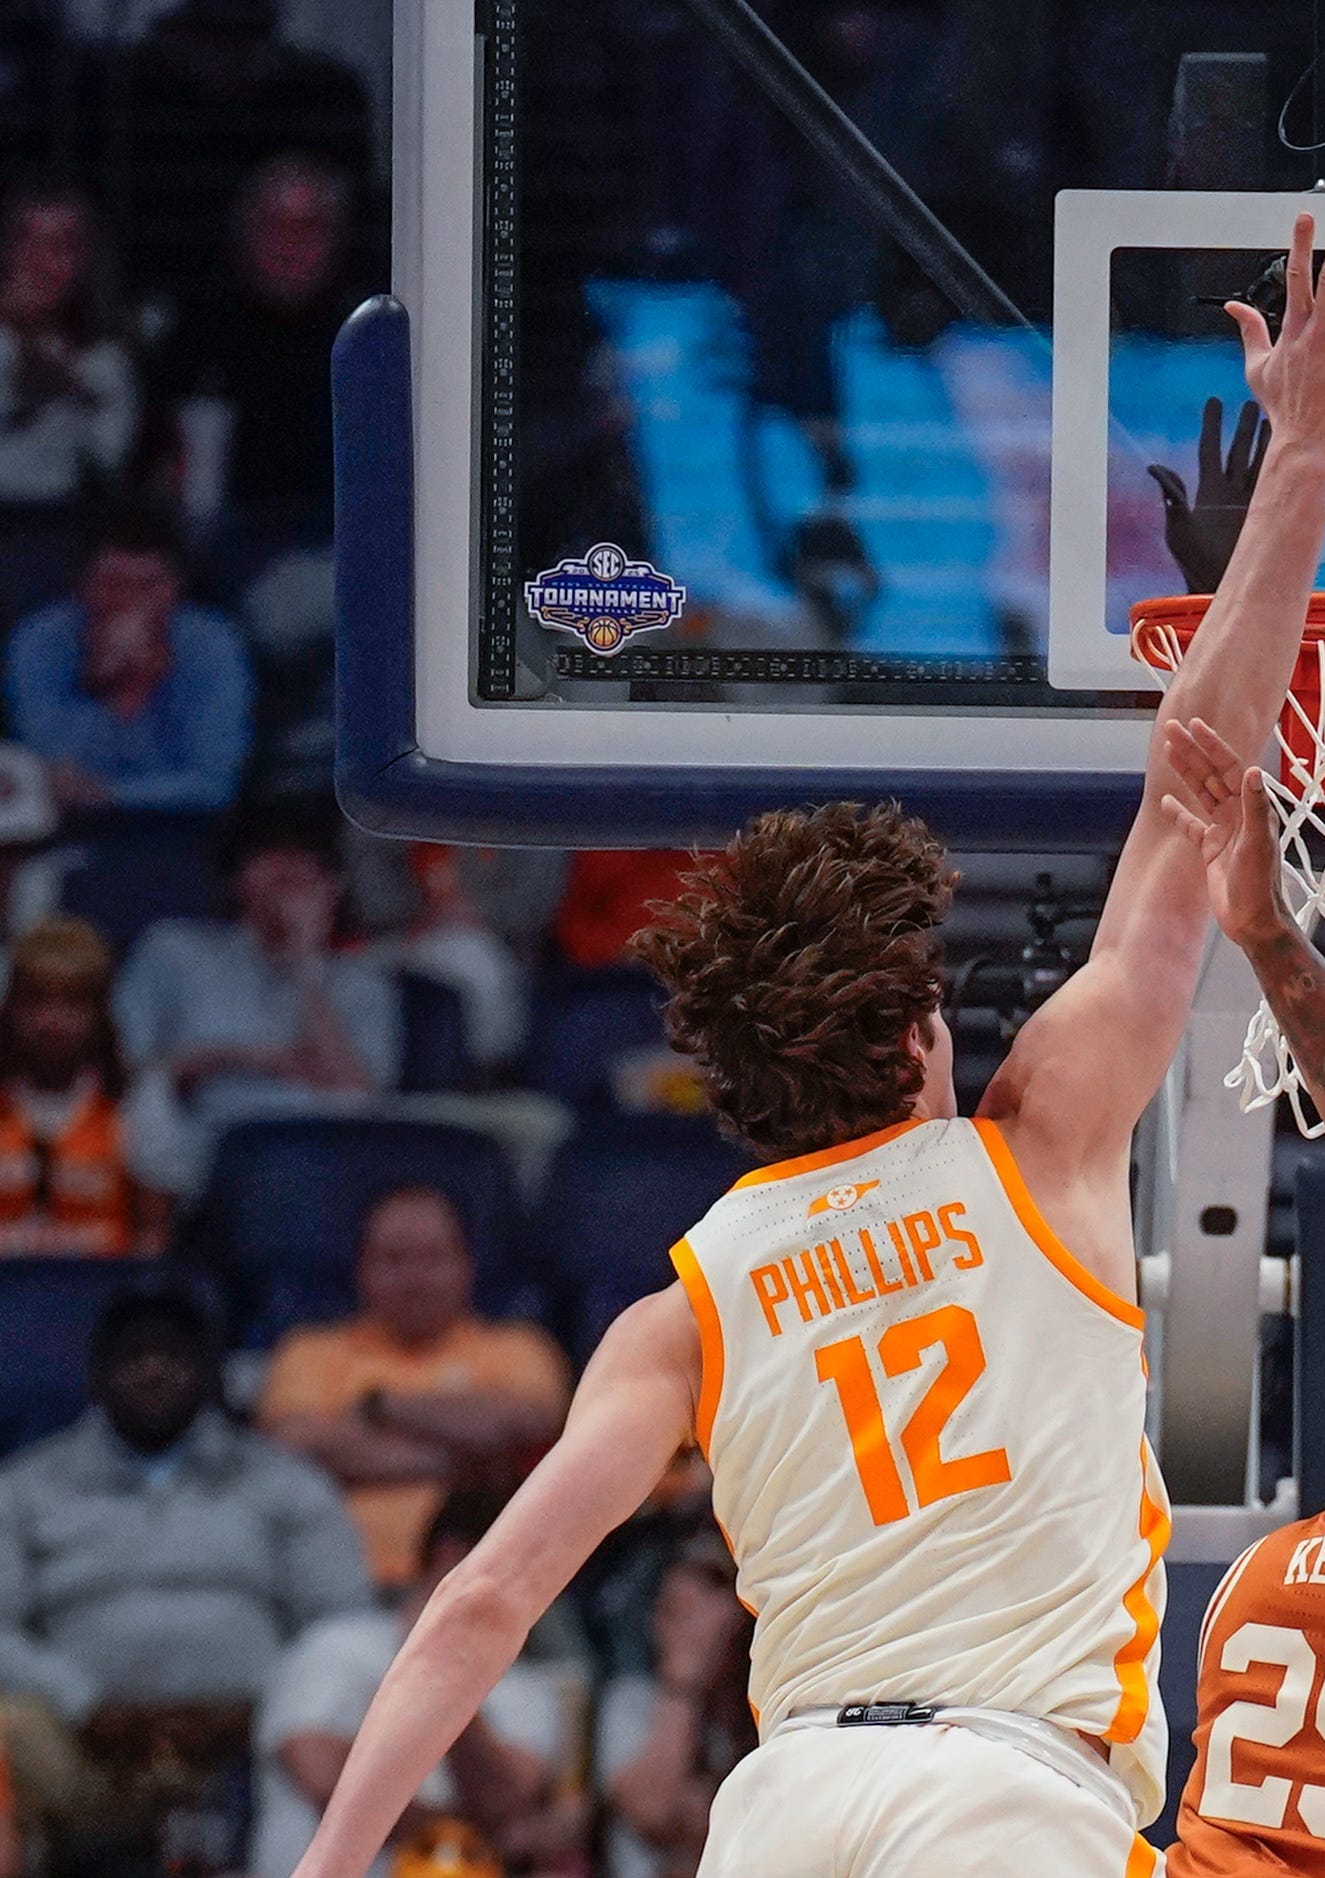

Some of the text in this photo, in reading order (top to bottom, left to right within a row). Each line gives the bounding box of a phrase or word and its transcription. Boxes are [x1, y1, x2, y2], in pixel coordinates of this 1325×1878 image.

[530, 588, 681, 612] TOURNAMENT
[592, 550, 620, 578] SEC
[749, 1202, 984, 1337] PHILLIPS
[814, 1303, 1012, 1527] 12
